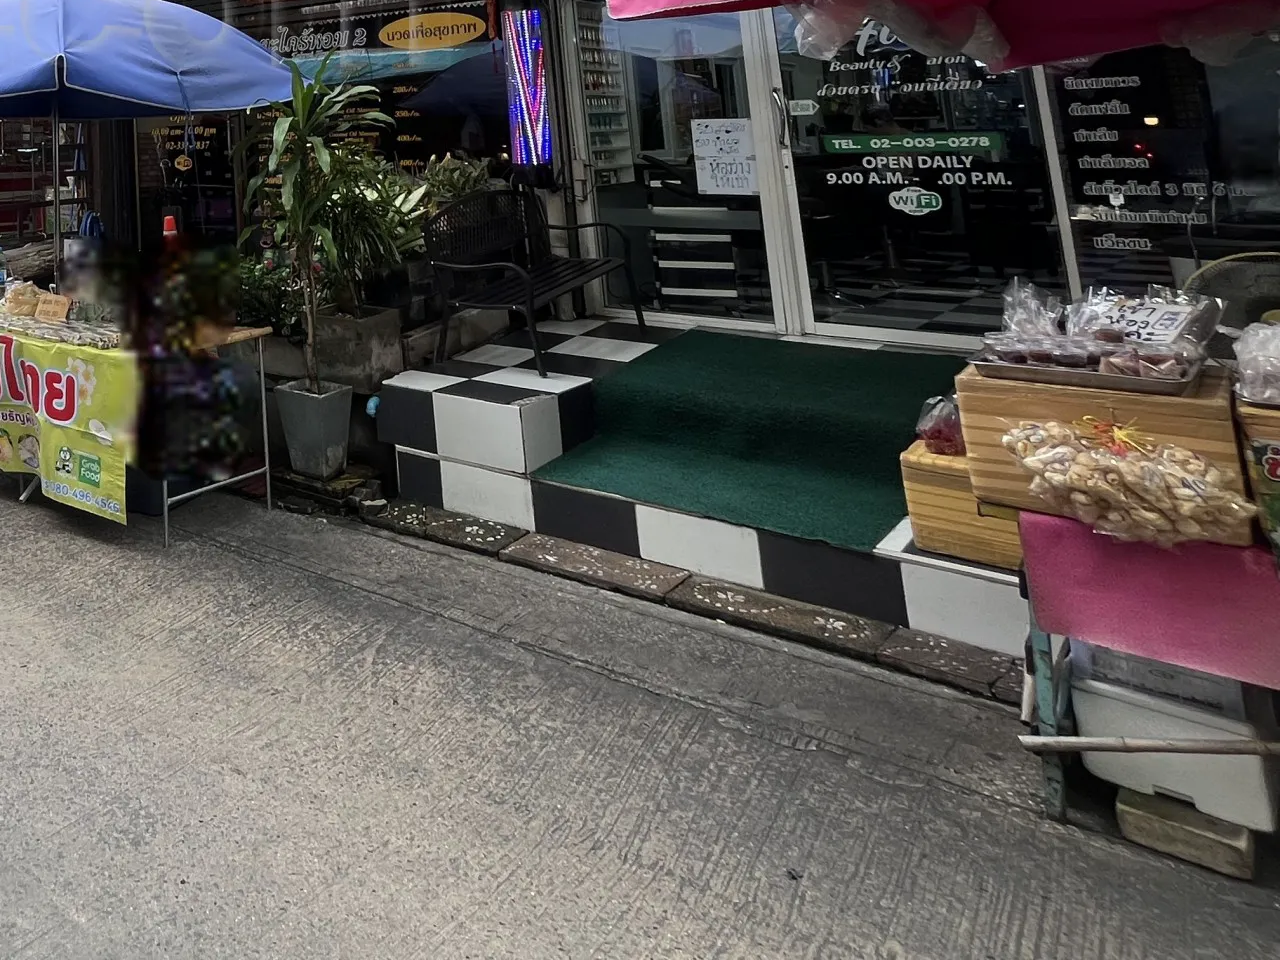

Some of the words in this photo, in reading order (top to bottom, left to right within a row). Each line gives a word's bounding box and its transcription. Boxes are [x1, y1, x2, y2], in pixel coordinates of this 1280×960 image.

[352, 26, 368, 46] 2
[829, 58, 886, 73] Beauty
[832, 139, 861, 149] TEL.
[870, 136, 990, 149] 02-003-0278
[862, 155, 913, 169] OPEN
[919, 155, 974, 169] DAILY
[826, 172, 864, 185] 9.00
[868, 171, 909, 185] A.M.
[971, 171, 1013, 186] P.M.
[1165, 183, 1179, 196] 3
[81, 458, 100, 472] Grab
[80, 467, 100, 483] Food
